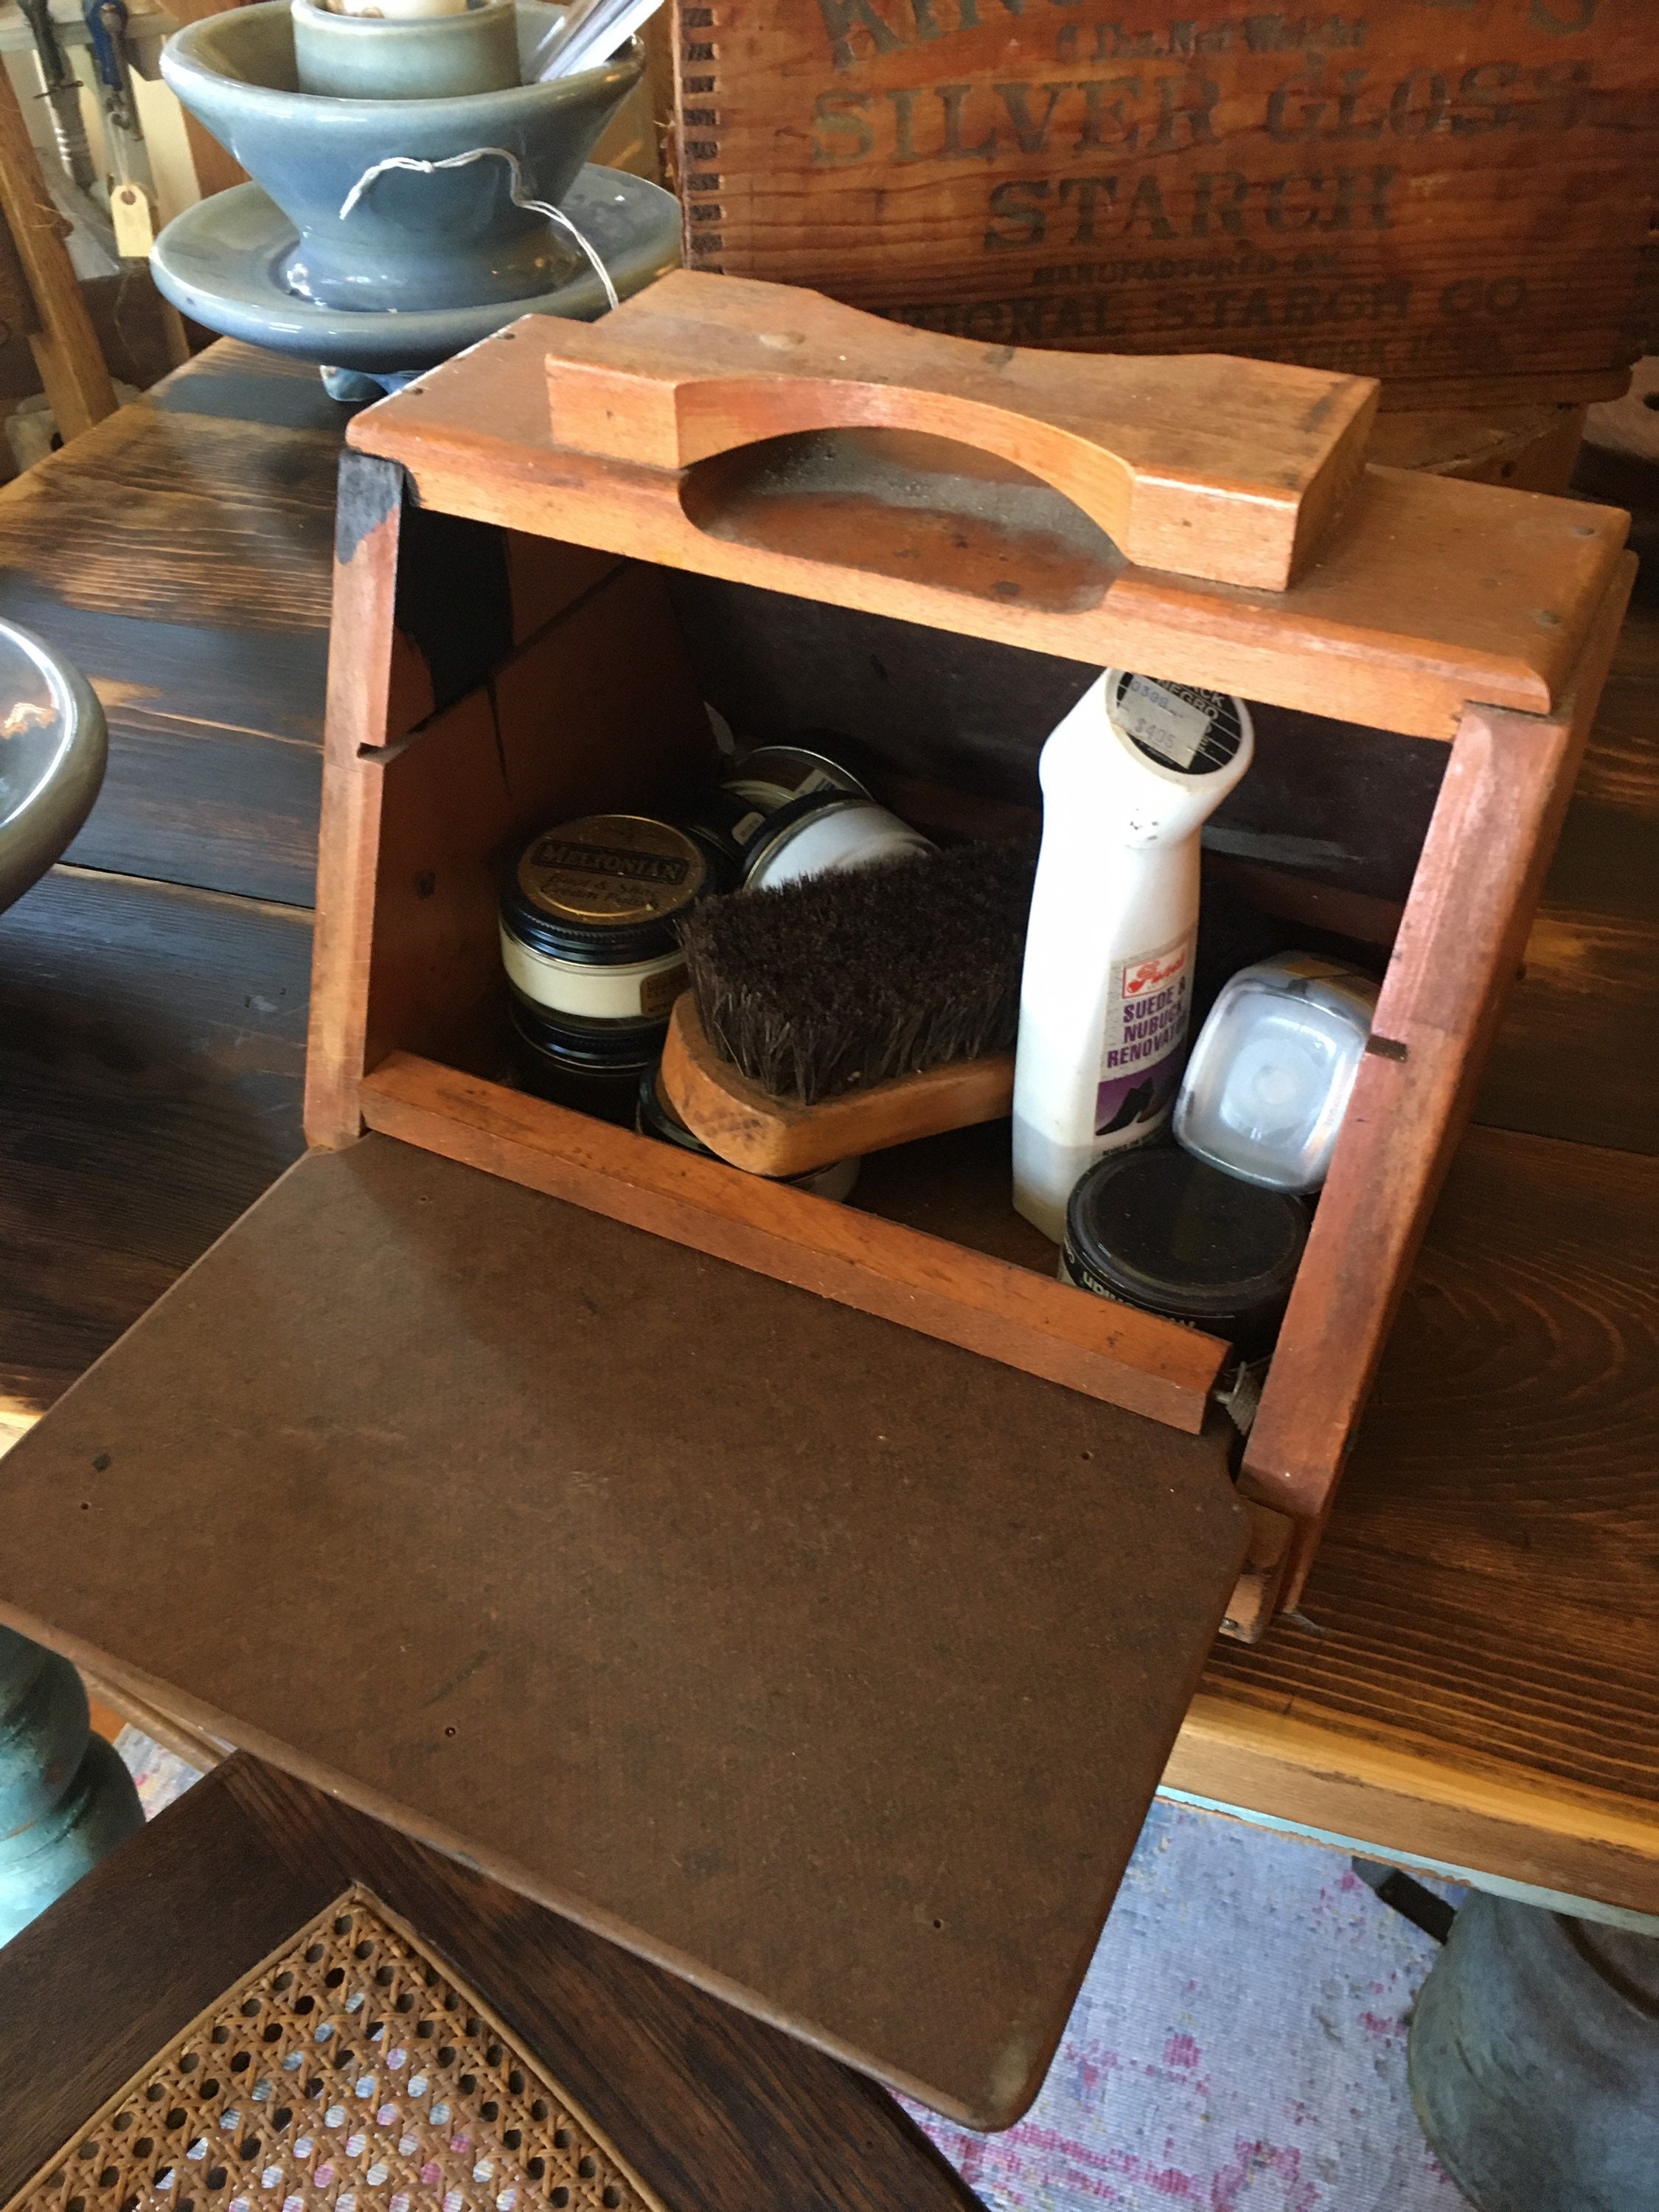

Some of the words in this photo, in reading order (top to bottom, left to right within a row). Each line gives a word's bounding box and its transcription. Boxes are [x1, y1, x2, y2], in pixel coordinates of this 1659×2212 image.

[810, 75, 1222, 167] SILVER
[1265, 60, 1596, 144] GLOSS
[984, 164, 1399, 250] STARCH
[1152, 277, 1413, 329] STARCH
[1123, 986, 1174, 1023] SUEDE
